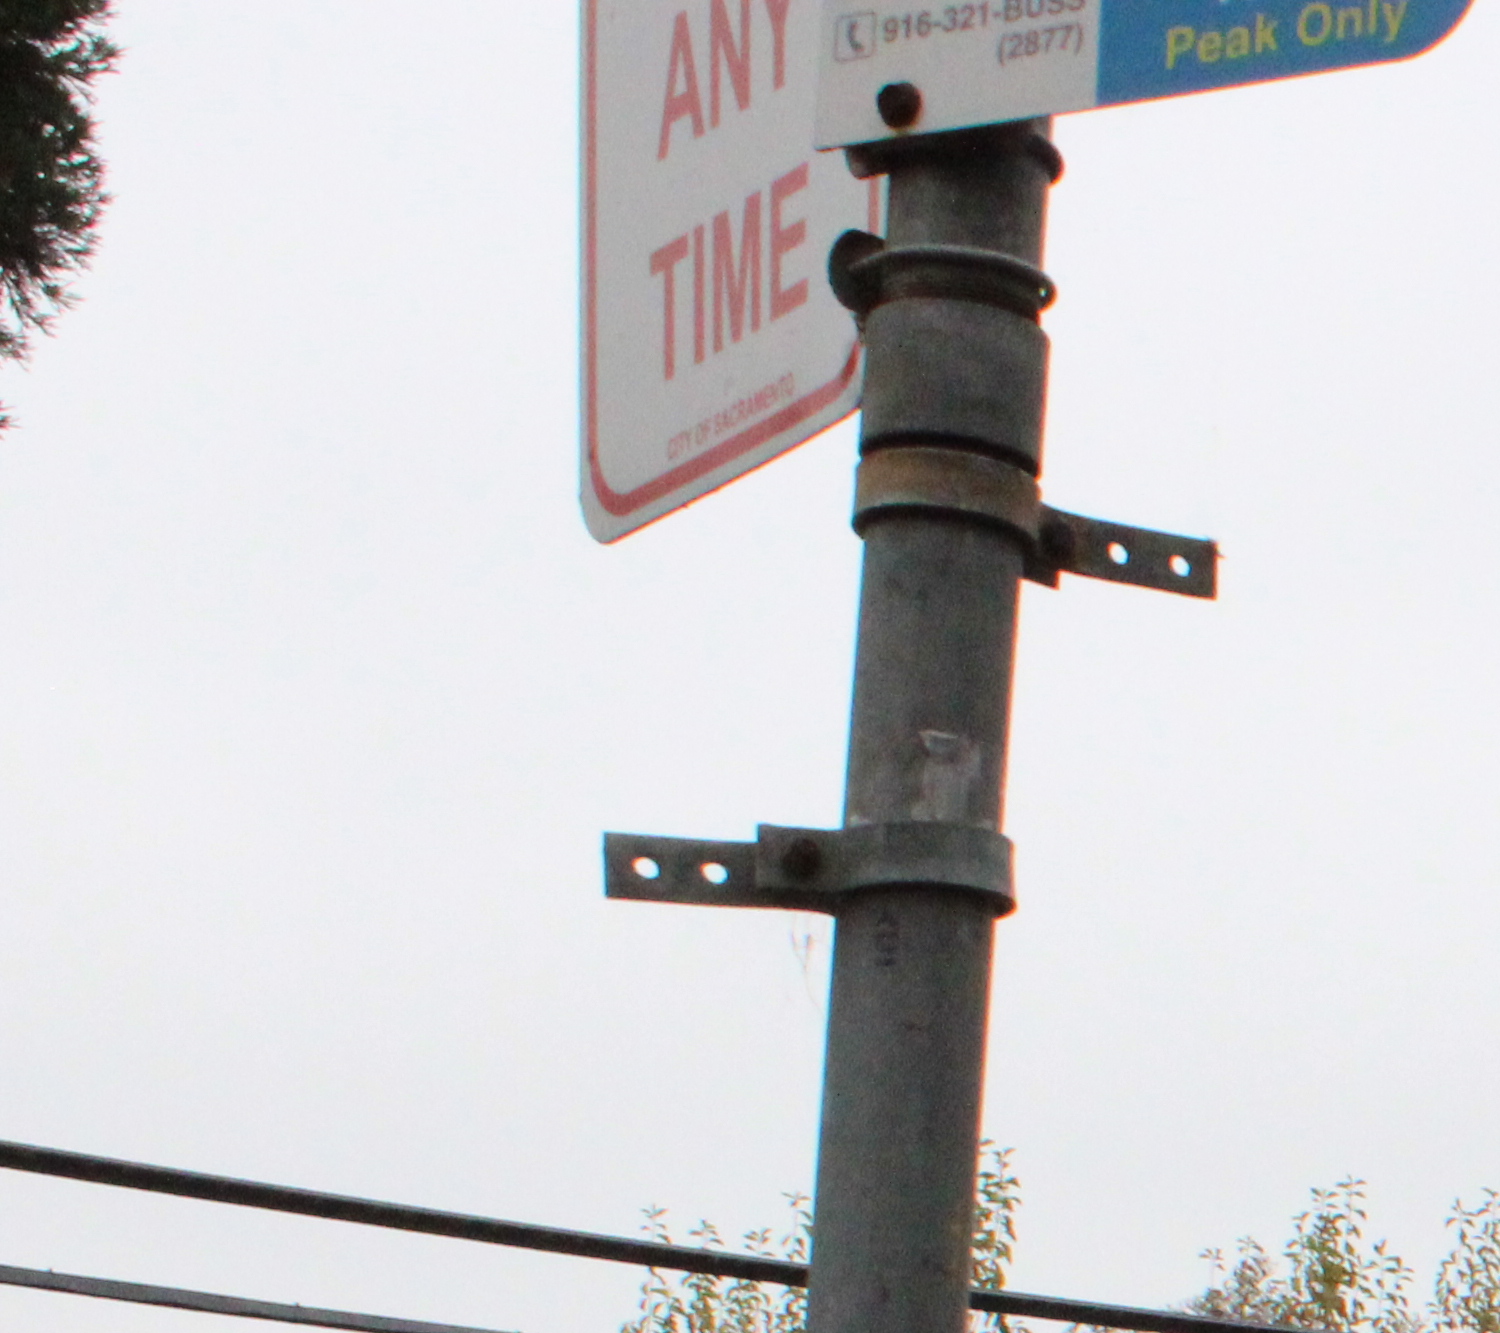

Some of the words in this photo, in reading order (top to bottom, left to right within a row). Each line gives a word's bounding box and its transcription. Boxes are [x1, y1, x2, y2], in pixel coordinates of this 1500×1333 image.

[657, 0, 791, 161] ANY
[997, 22, 1084, 66] (2877)
[1166, 13, 1278, 69] Peak
[1297, 0, 1408, 46] Only
[650, 161, 809, 381] TIME
